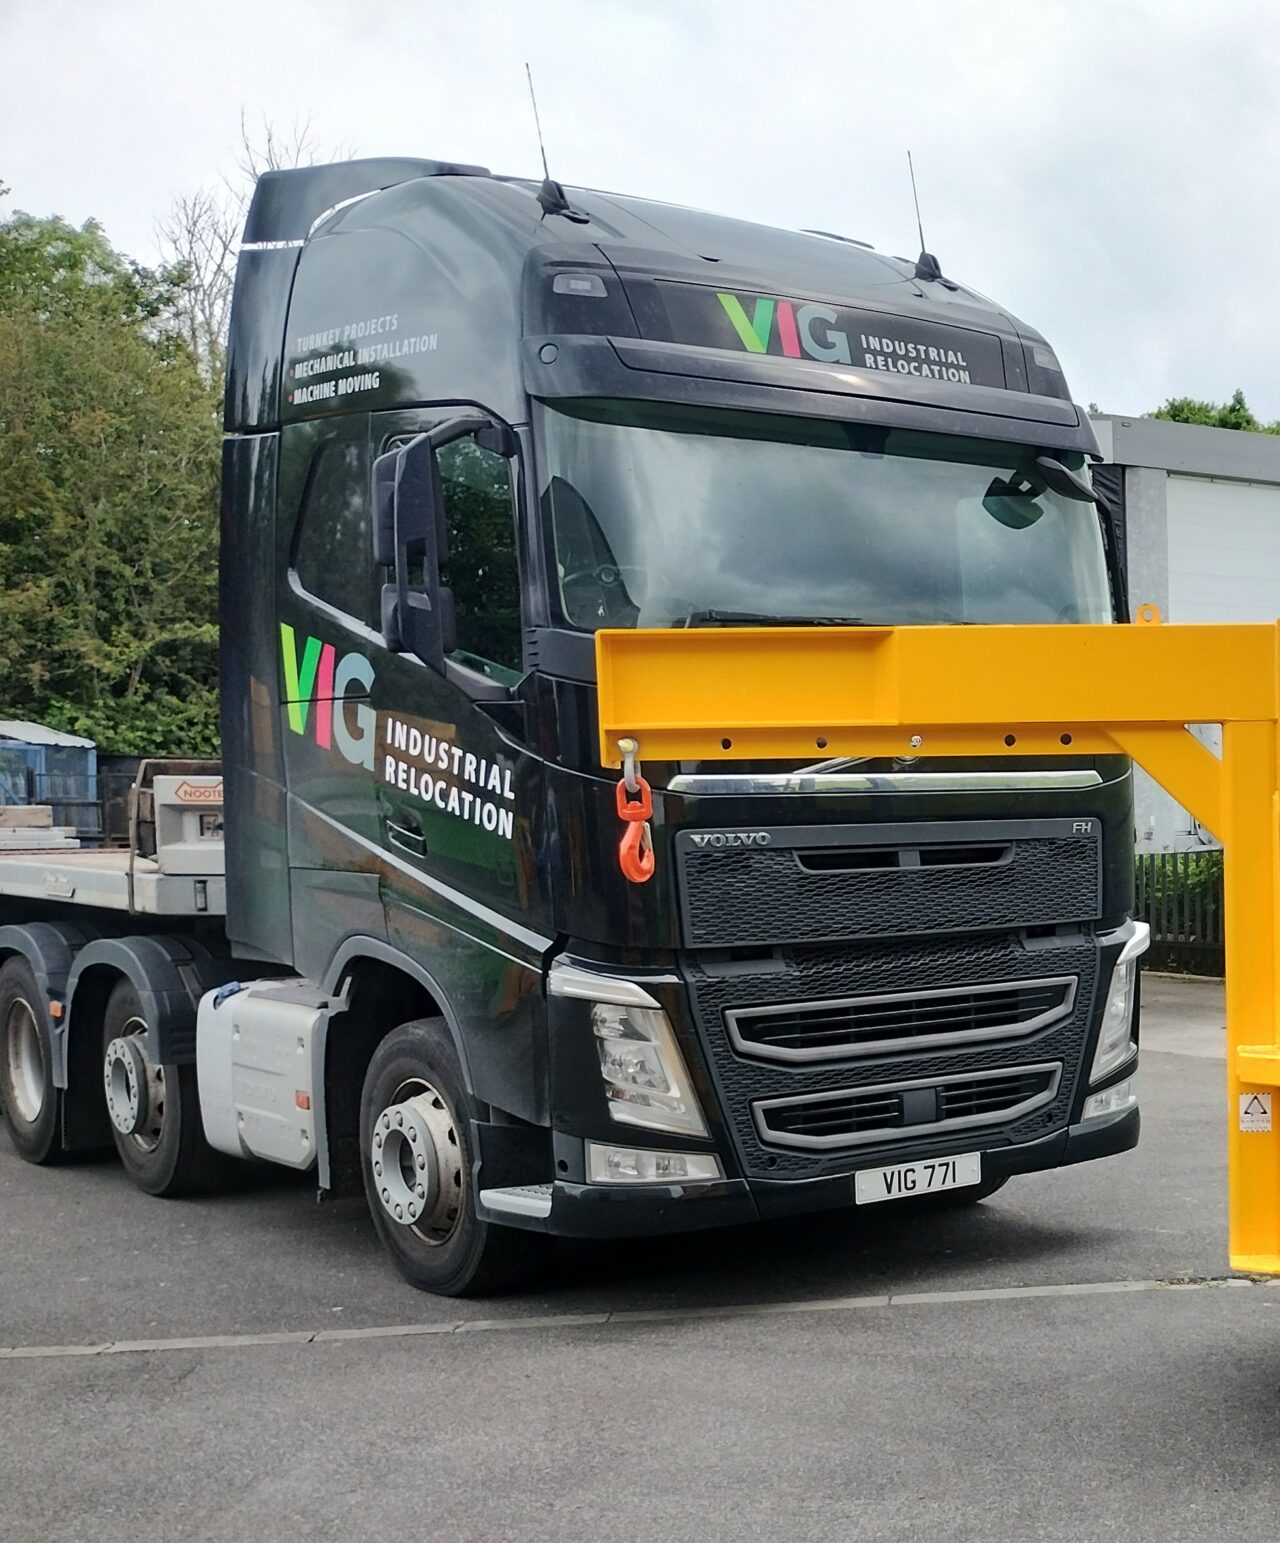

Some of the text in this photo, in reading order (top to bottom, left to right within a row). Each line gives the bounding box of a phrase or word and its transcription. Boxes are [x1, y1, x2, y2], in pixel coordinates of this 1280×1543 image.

[297, 314, 398, 353] TURNKEY PROJECTS
[716, 293, 852, 364] VIG
[295, 333, 438, 379] MECHANICAL INSTALLATION
[860, 334, 967, 366] INDUSTRIAL
[865, 353, 970, 384] RELOCATION
[293, 371, 380, 405] MACHINE MOVING
[280, 622, 377, 772] VIG
[386, 717, 515, 800] INDUSTRIAL
[385, 755, 514, 840] RELOCATION
[690, 832, 771, 847] VOLVO
[1072, 822, 1092, 834] FH
[883, 1161, 956, 1194] VIG 771
